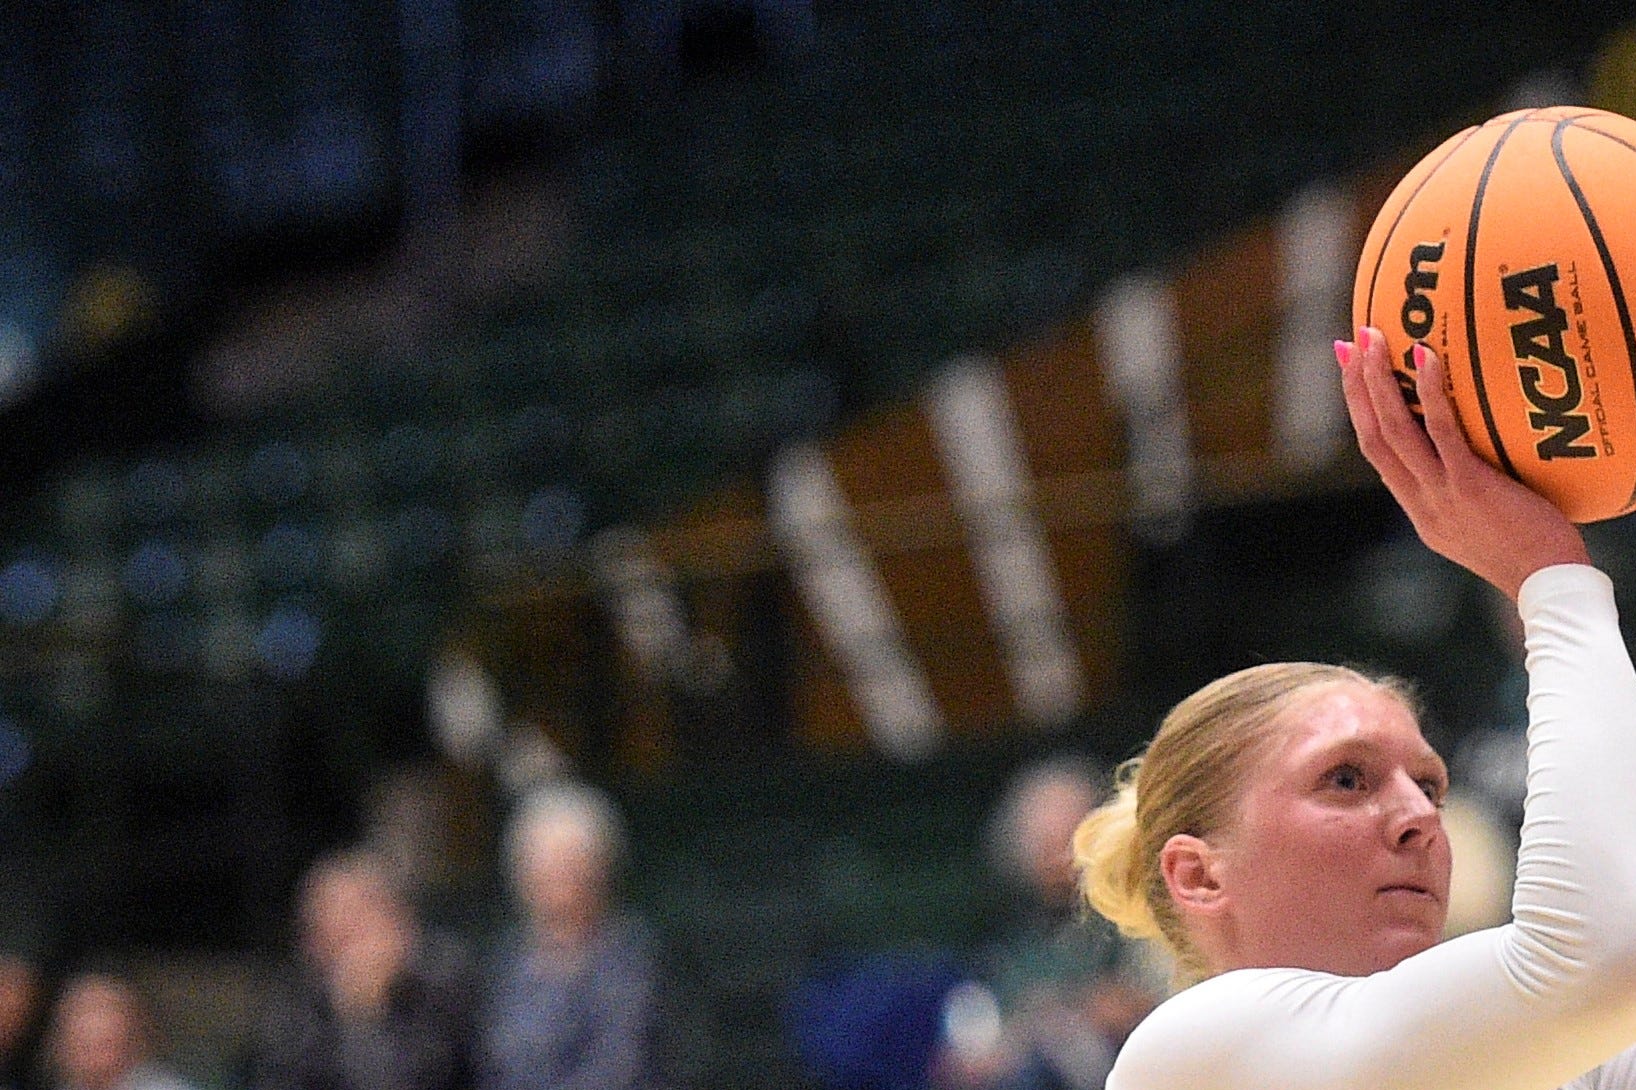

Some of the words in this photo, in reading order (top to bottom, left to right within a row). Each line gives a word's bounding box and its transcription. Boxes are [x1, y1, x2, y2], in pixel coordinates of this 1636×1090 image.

[1567, 261, 1583, 315] BALL
[1502, 263, 1598, 460] NCAA
[1576, 320, 1596, 378] GAME
[1590, 383, 1615, 456] OFFICIAL
